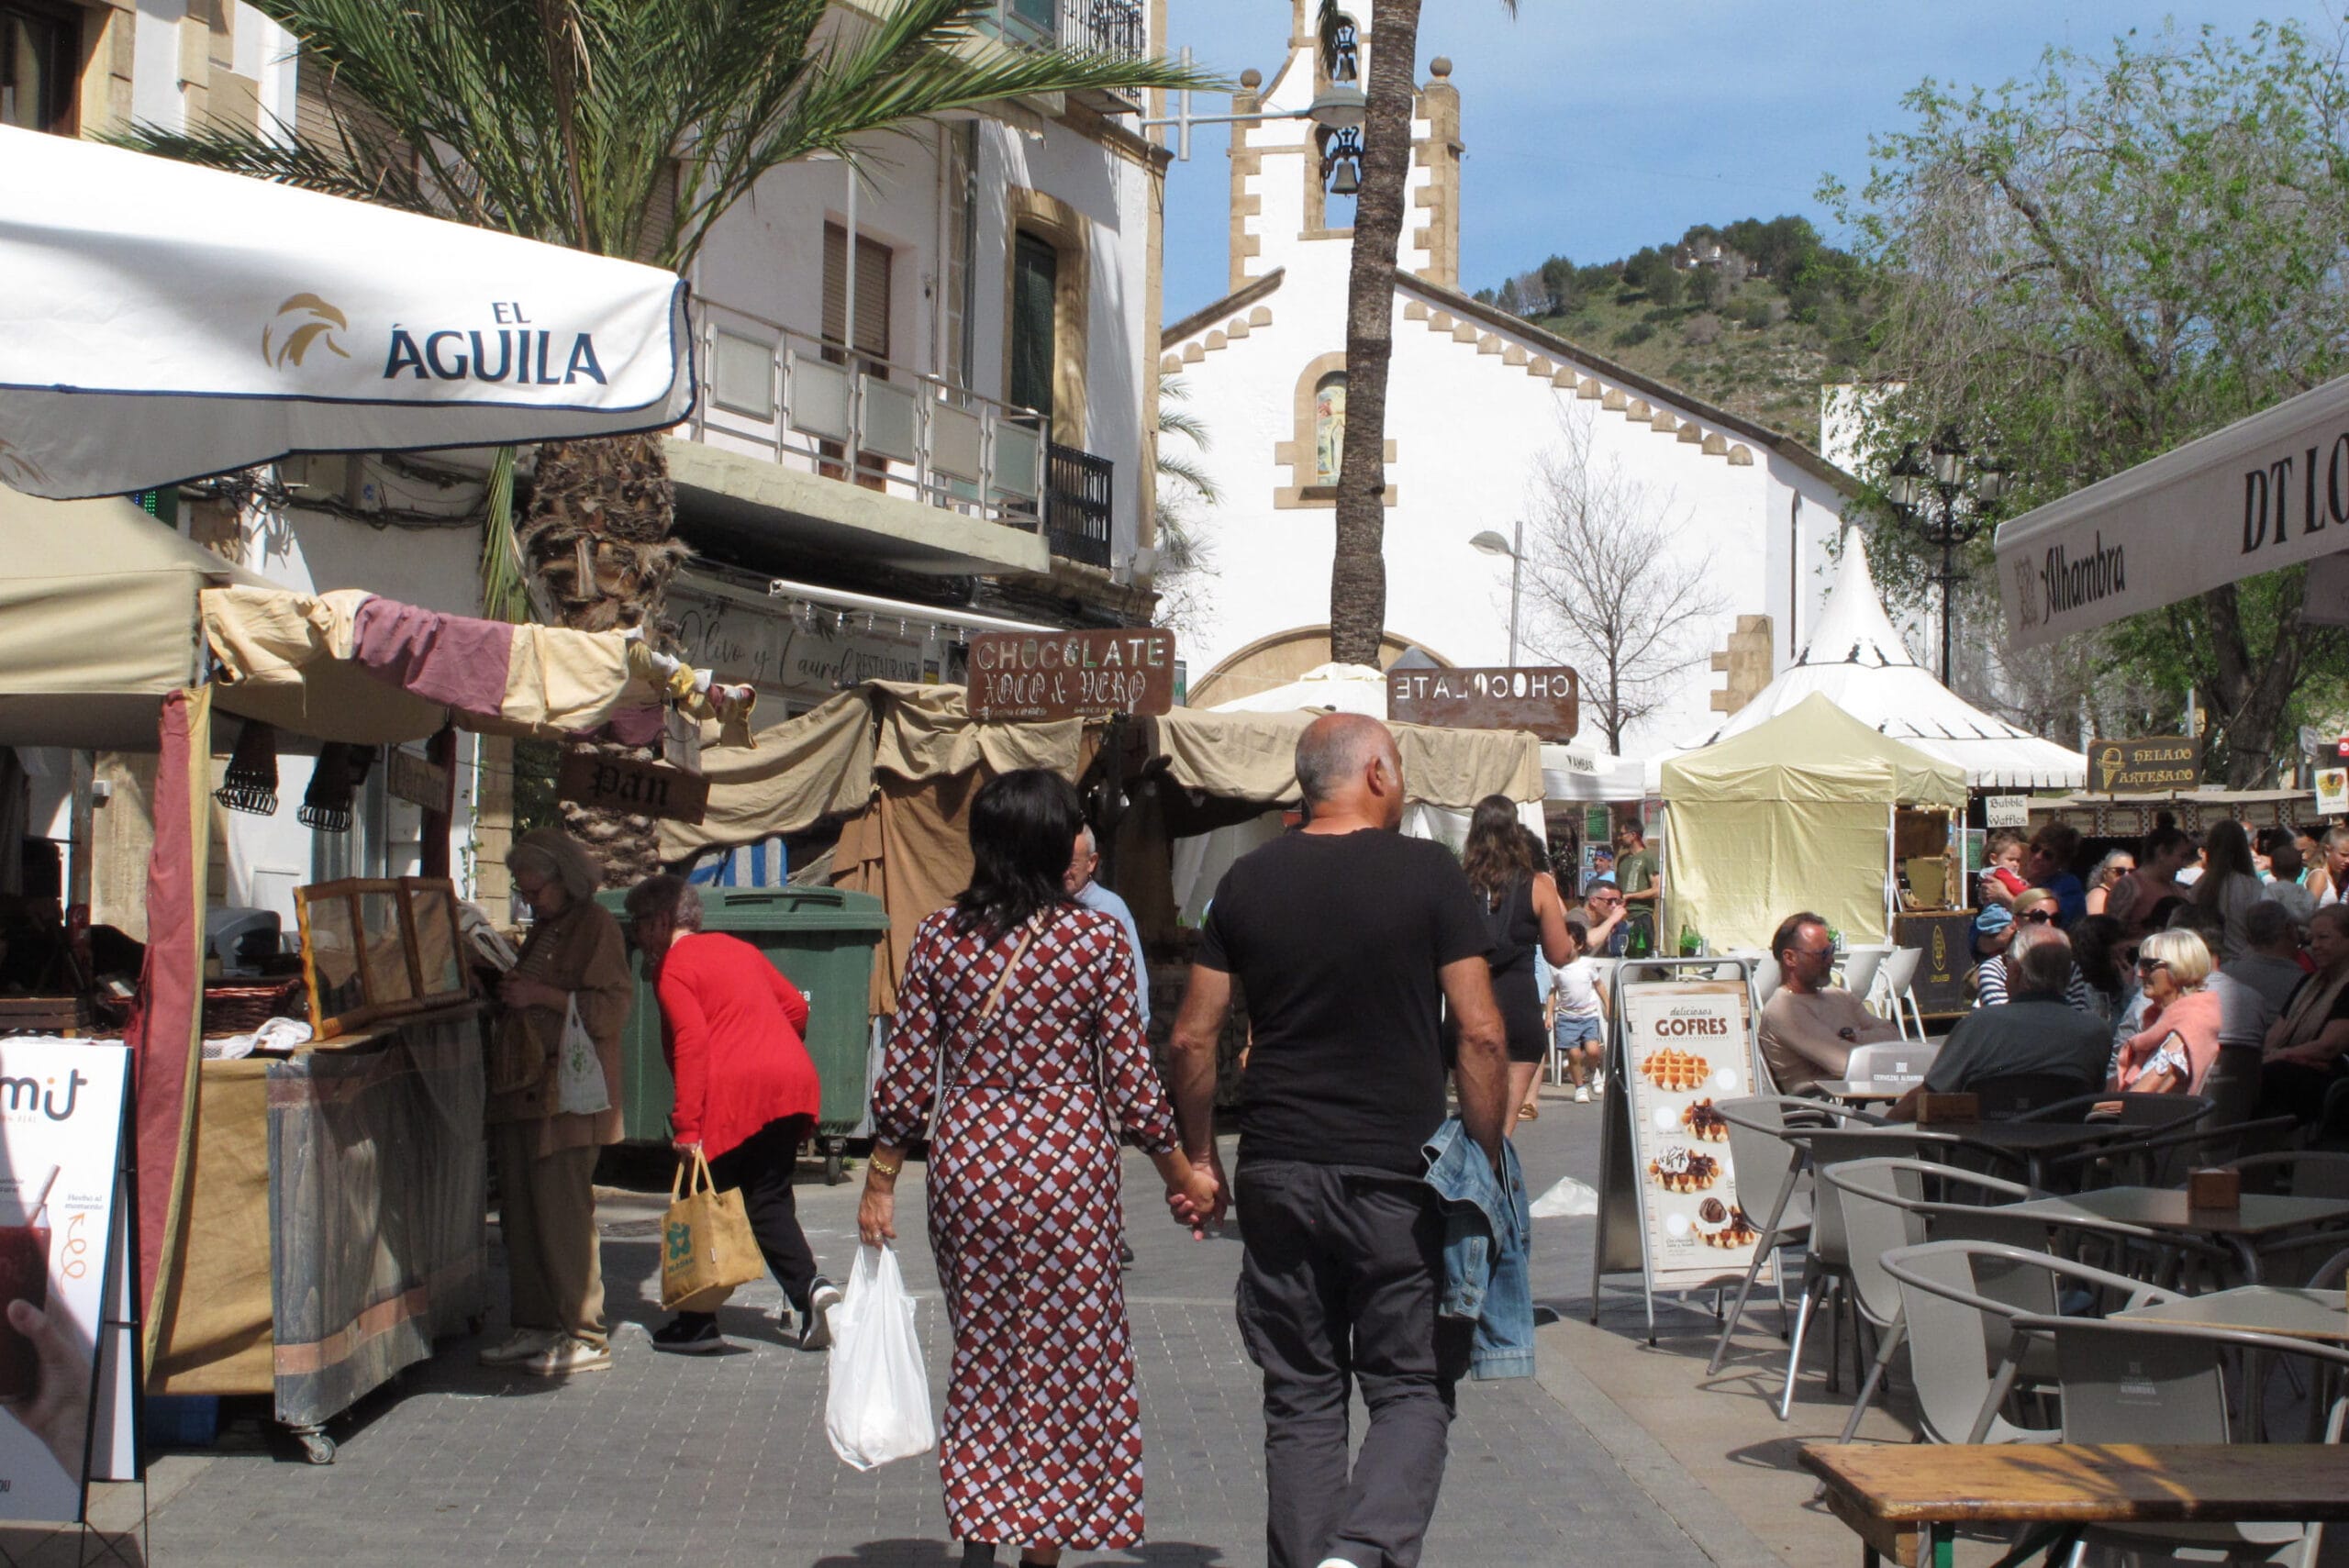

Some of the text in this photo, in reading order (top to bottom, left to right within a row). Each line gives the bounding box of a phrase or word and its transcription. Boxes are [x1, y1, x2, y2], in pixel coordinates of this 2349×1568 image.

[492, 302, 532, 325] EL
[383, 322, 608, 385] ÁGUILA
[2040, 528, 2126, 625] Alhambra
[675, 610, 746, 664] Olivo
[778, 627, 852, 687] Laurel
[976, 637, 1165, 671] CHOCOLATE
[589, 763, 670, 806] Pan
[1987, 797, 2024, 809] Bubble
[1988, 813, 2027, 826] Waffles
[1670, 1006, 1712, 1016] deliciosos
[1655, 1018, 1728, 1036] GOFRES
